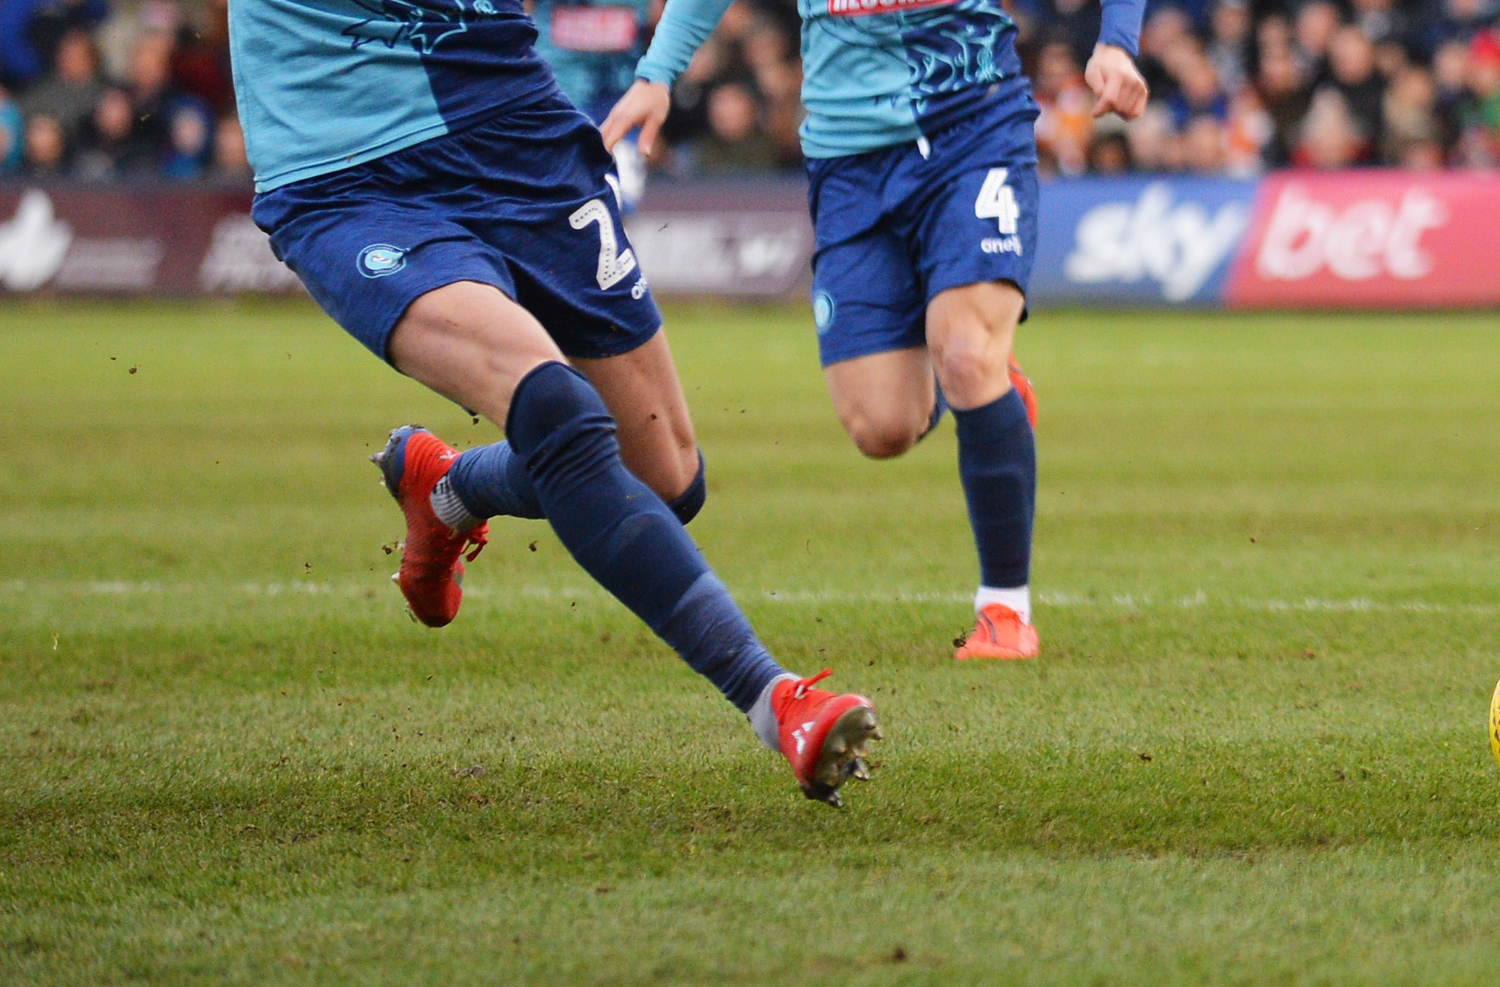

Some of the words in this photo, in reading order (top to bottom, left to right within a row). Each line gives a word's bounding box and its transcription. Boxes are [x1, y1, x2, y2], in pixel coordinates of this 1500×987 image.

[569, 174, 637, 291] 2
[975, 167, 1020, 235] 4
[1064, 181, 1246, 302] sky
[1257, 182, 1450, 281] bet
